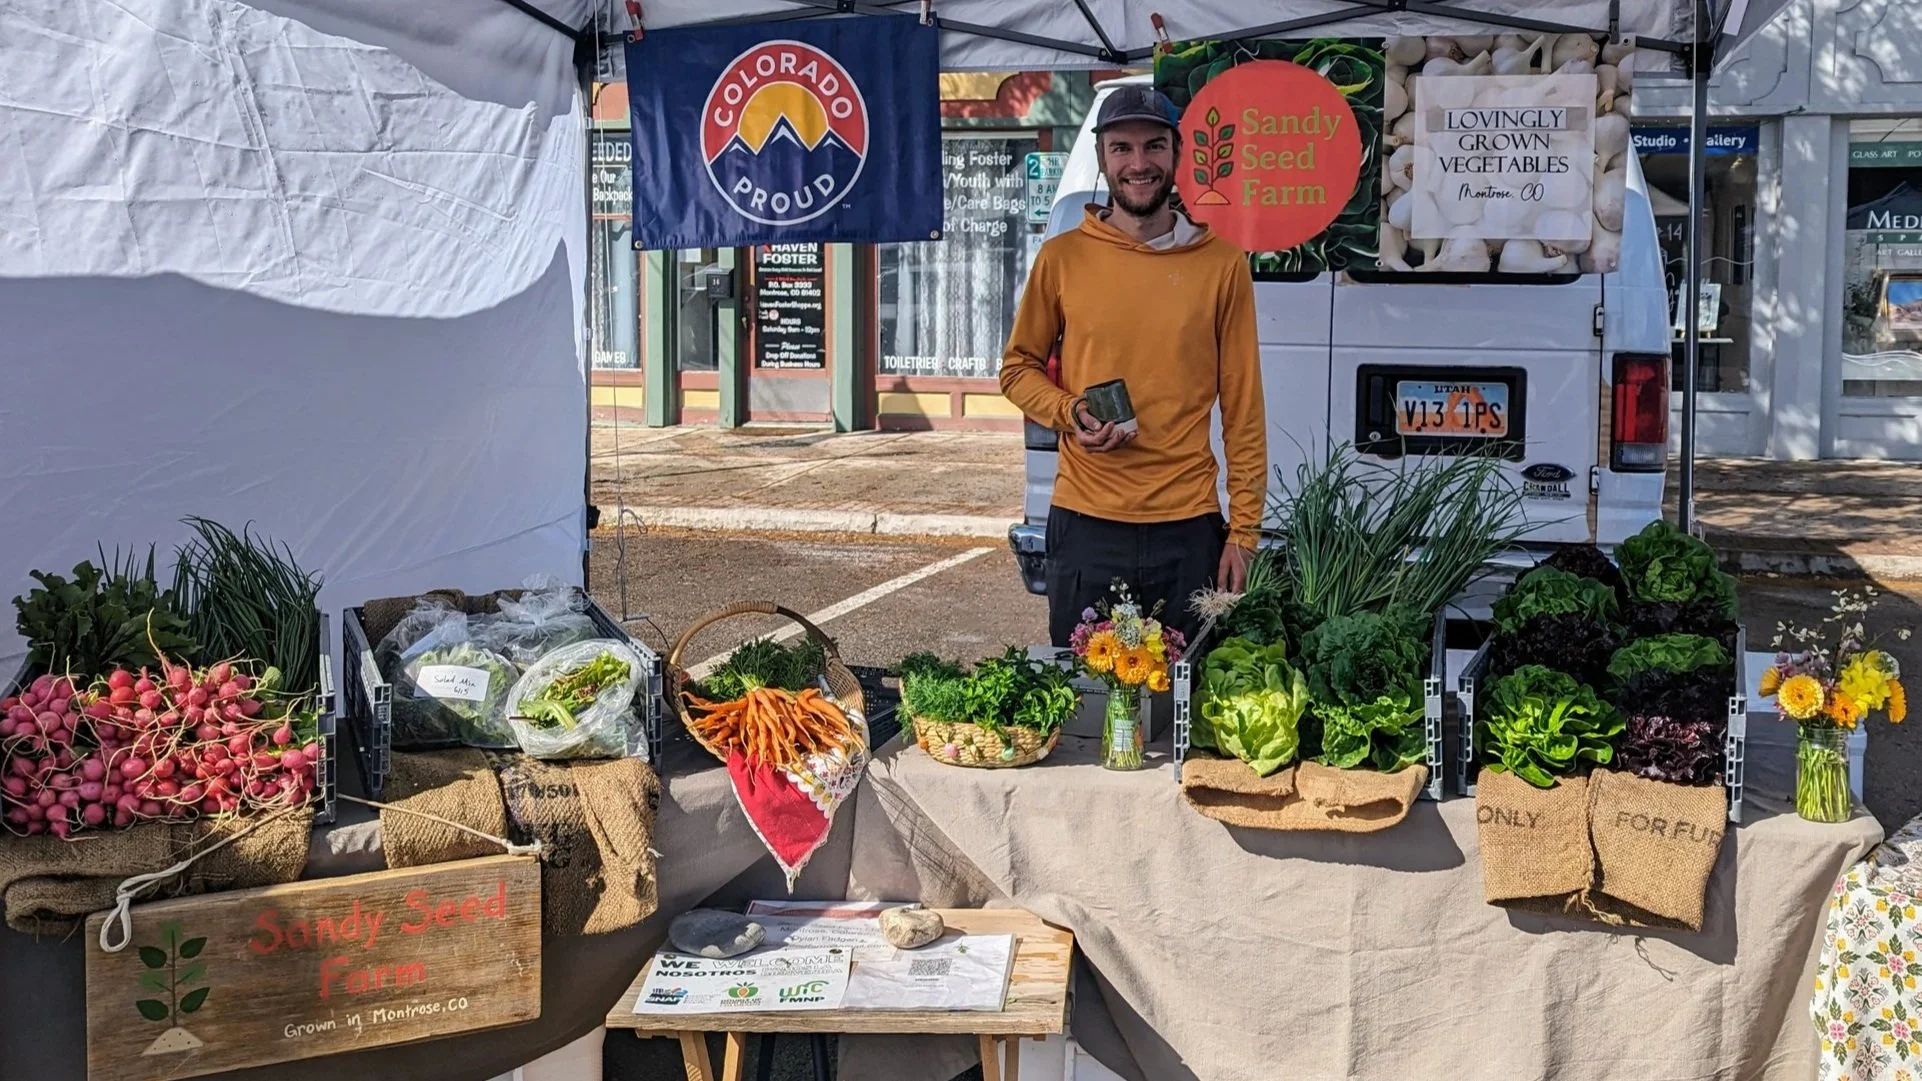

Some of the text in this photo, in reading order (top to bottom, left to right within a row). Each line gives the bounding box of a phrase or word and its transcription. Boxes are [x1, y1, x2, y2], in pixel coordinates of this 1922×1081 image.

[714, 52, 853, 127] COLORADO
[1241, 106, 1342, 140] Sandy
[1447, 110, 1564, 129] LOVINGLY
[1458, 133, 1550, 151] GROWN
[1633, 134, 1746, 148] Studio allery
[969, 151, 1013, 166] Foster
[1241, 142, 1315, 170] Seed
[1852, 150, 1878, 159] GLASS
[1881, 150, 1899, 158] ART
[1028, 159, 1039, 176] 2
[1439, 156, 1570, 173] VEGETABLES
[600, 170, 616, 183] Our
[995, 171, 1024, 188] with
[733, 173, 835, 214] PROUD
[1037, 184, 1043, 194] 8
[1242, 179, 1327, 206] Farm
[1520, 182, 1545, 202] CO
[993, 195, 1027, 214] Bags
[1031, 195, 1050, 206] TO 5
[943, 218, 1008, 237] of Charge
[771, 243, 818, 253] HAVEN
[1877, 248, 1892, 257] ART
[763, 253, 818, 265] FOSTER
[760, 289, 789, 297] Montrose,
[762, 326, 787, 334] Saturday
[594, 351, 626, 363] GAMES
[884, 356, 938, 369] TOILETRIES
[948, 357, 986, 370] CRAFTS
[1434, 385, 1471, 394] UTAH
[1404, 400, 1502, 429] V13 1PS
[1533, 466, 1561, 479] Ford
[1476, 805, 1542, 829] ONLY
[1615, 811, 1666, 837] FOR
[249, 878, 507, 954] Sandy Seed
[660, 958, 701, 970] WE
[712, 953, 844, 970] WELCOME
[319, 954, 426, 1001] Farm
[655, 969, 758, 978] NOSOTROS
[284, 1019, 337, 1039] Grown
